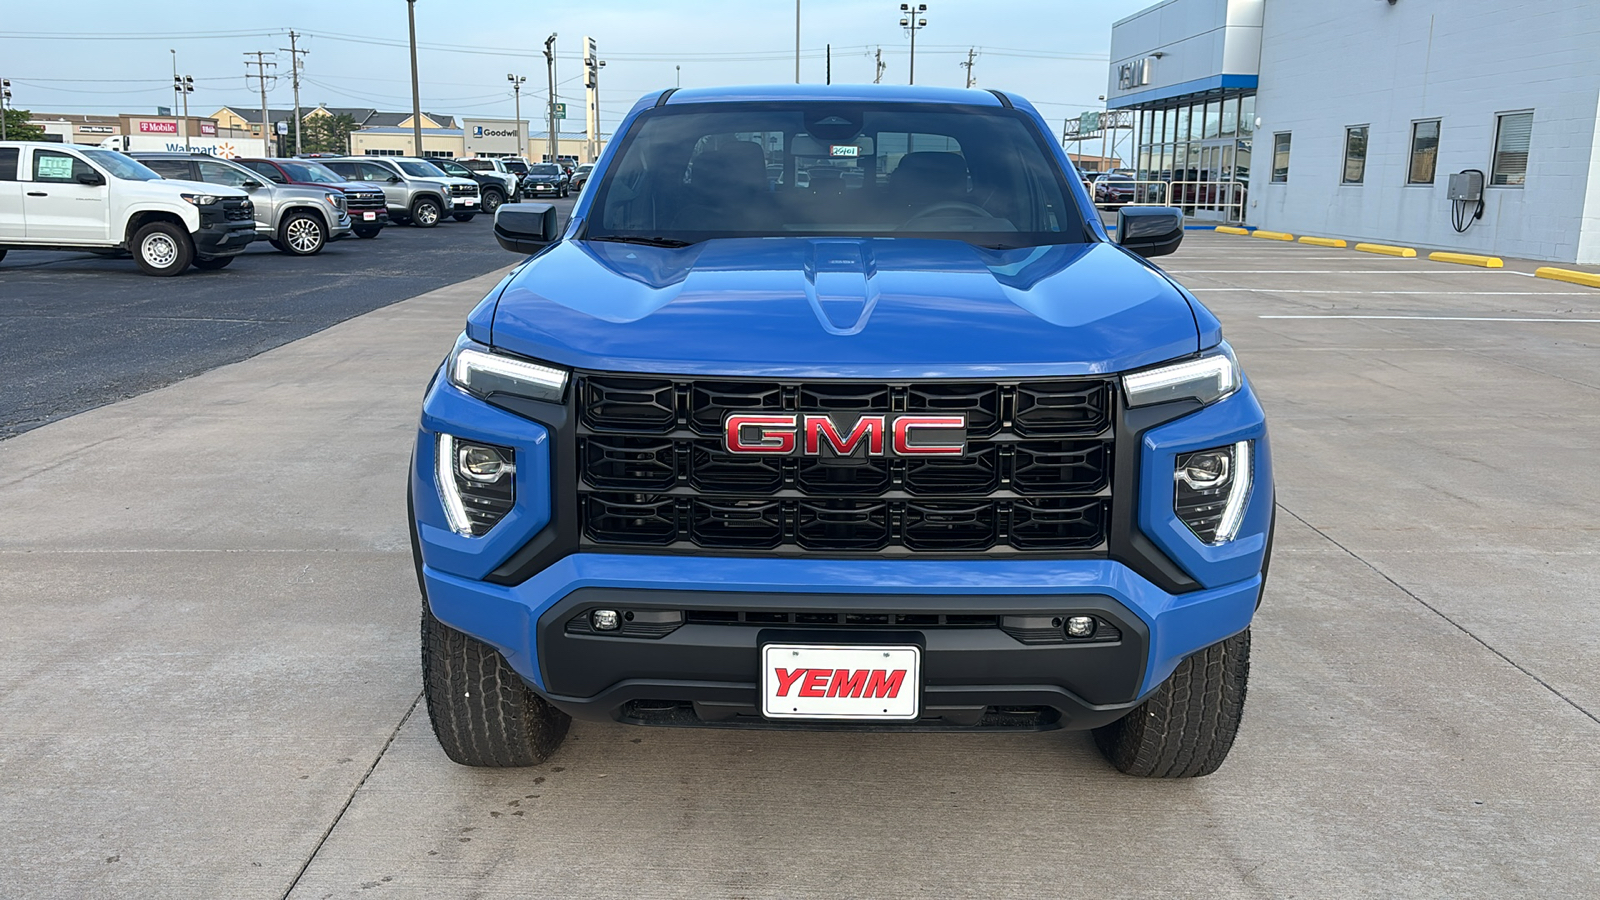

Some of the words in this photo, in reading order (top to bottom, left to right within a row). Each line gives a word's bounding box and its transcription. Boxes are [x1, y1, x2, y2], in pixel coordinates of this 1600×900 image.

[165, 143, 218, 156] Walmart
[725, 414, 966, 456] GMC
[774, 667, 907, 698] YEMM
